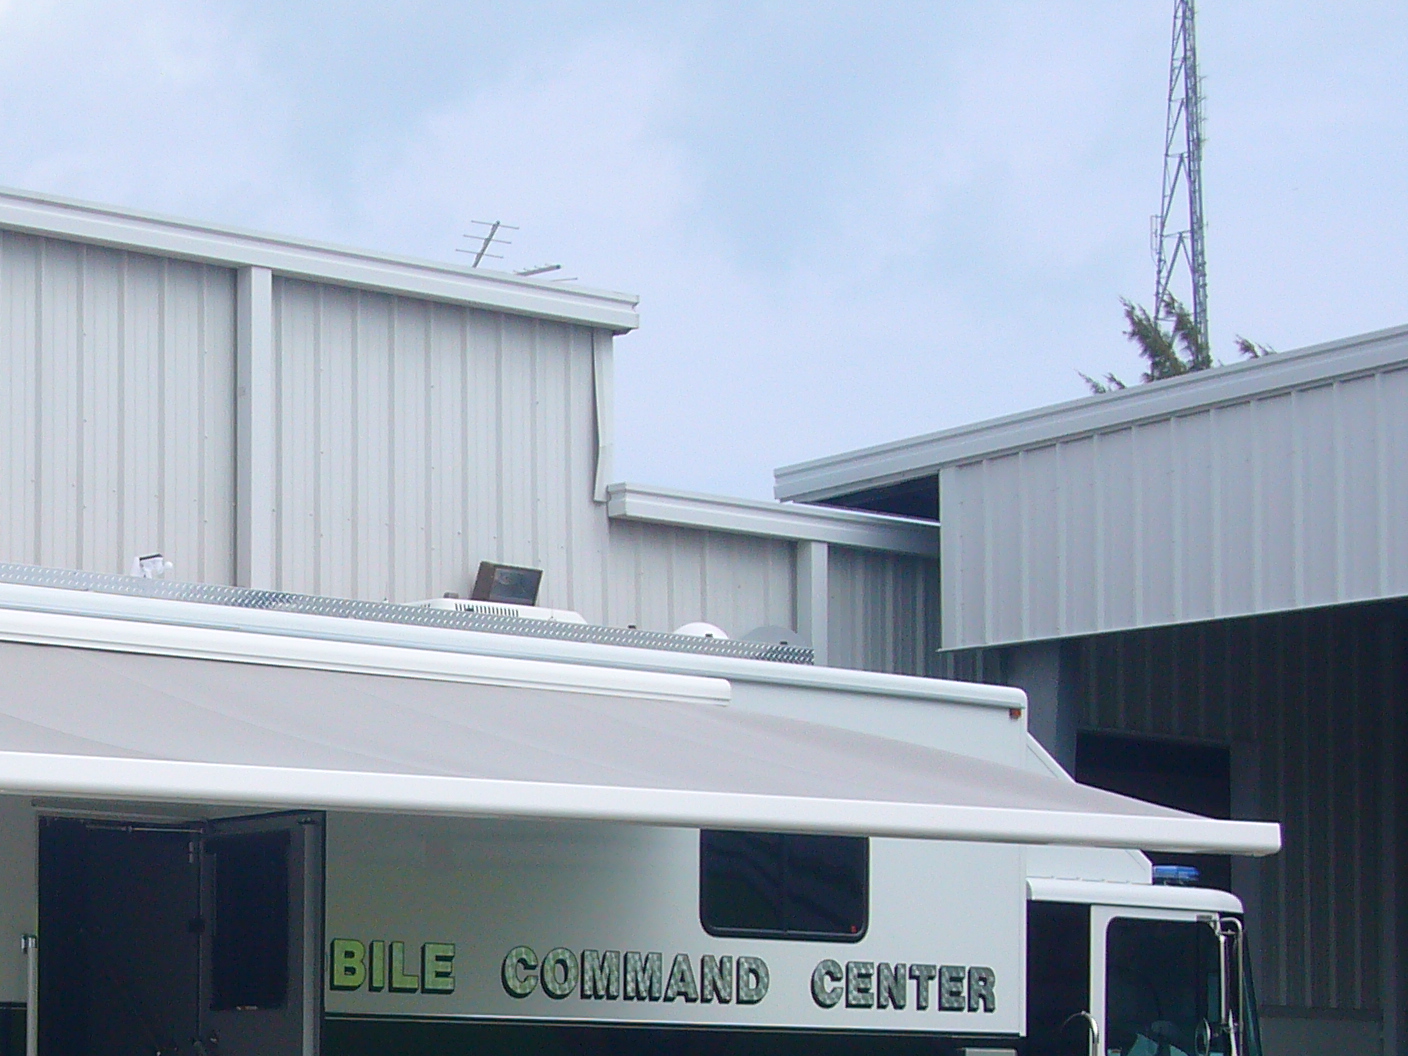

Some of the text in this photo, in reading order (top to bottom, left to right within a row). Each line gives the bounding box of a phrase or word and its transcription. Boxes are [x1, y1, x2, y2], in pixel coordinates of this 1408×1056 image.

[326, 937, 996, 1013] BILE COMMAND CENTER
